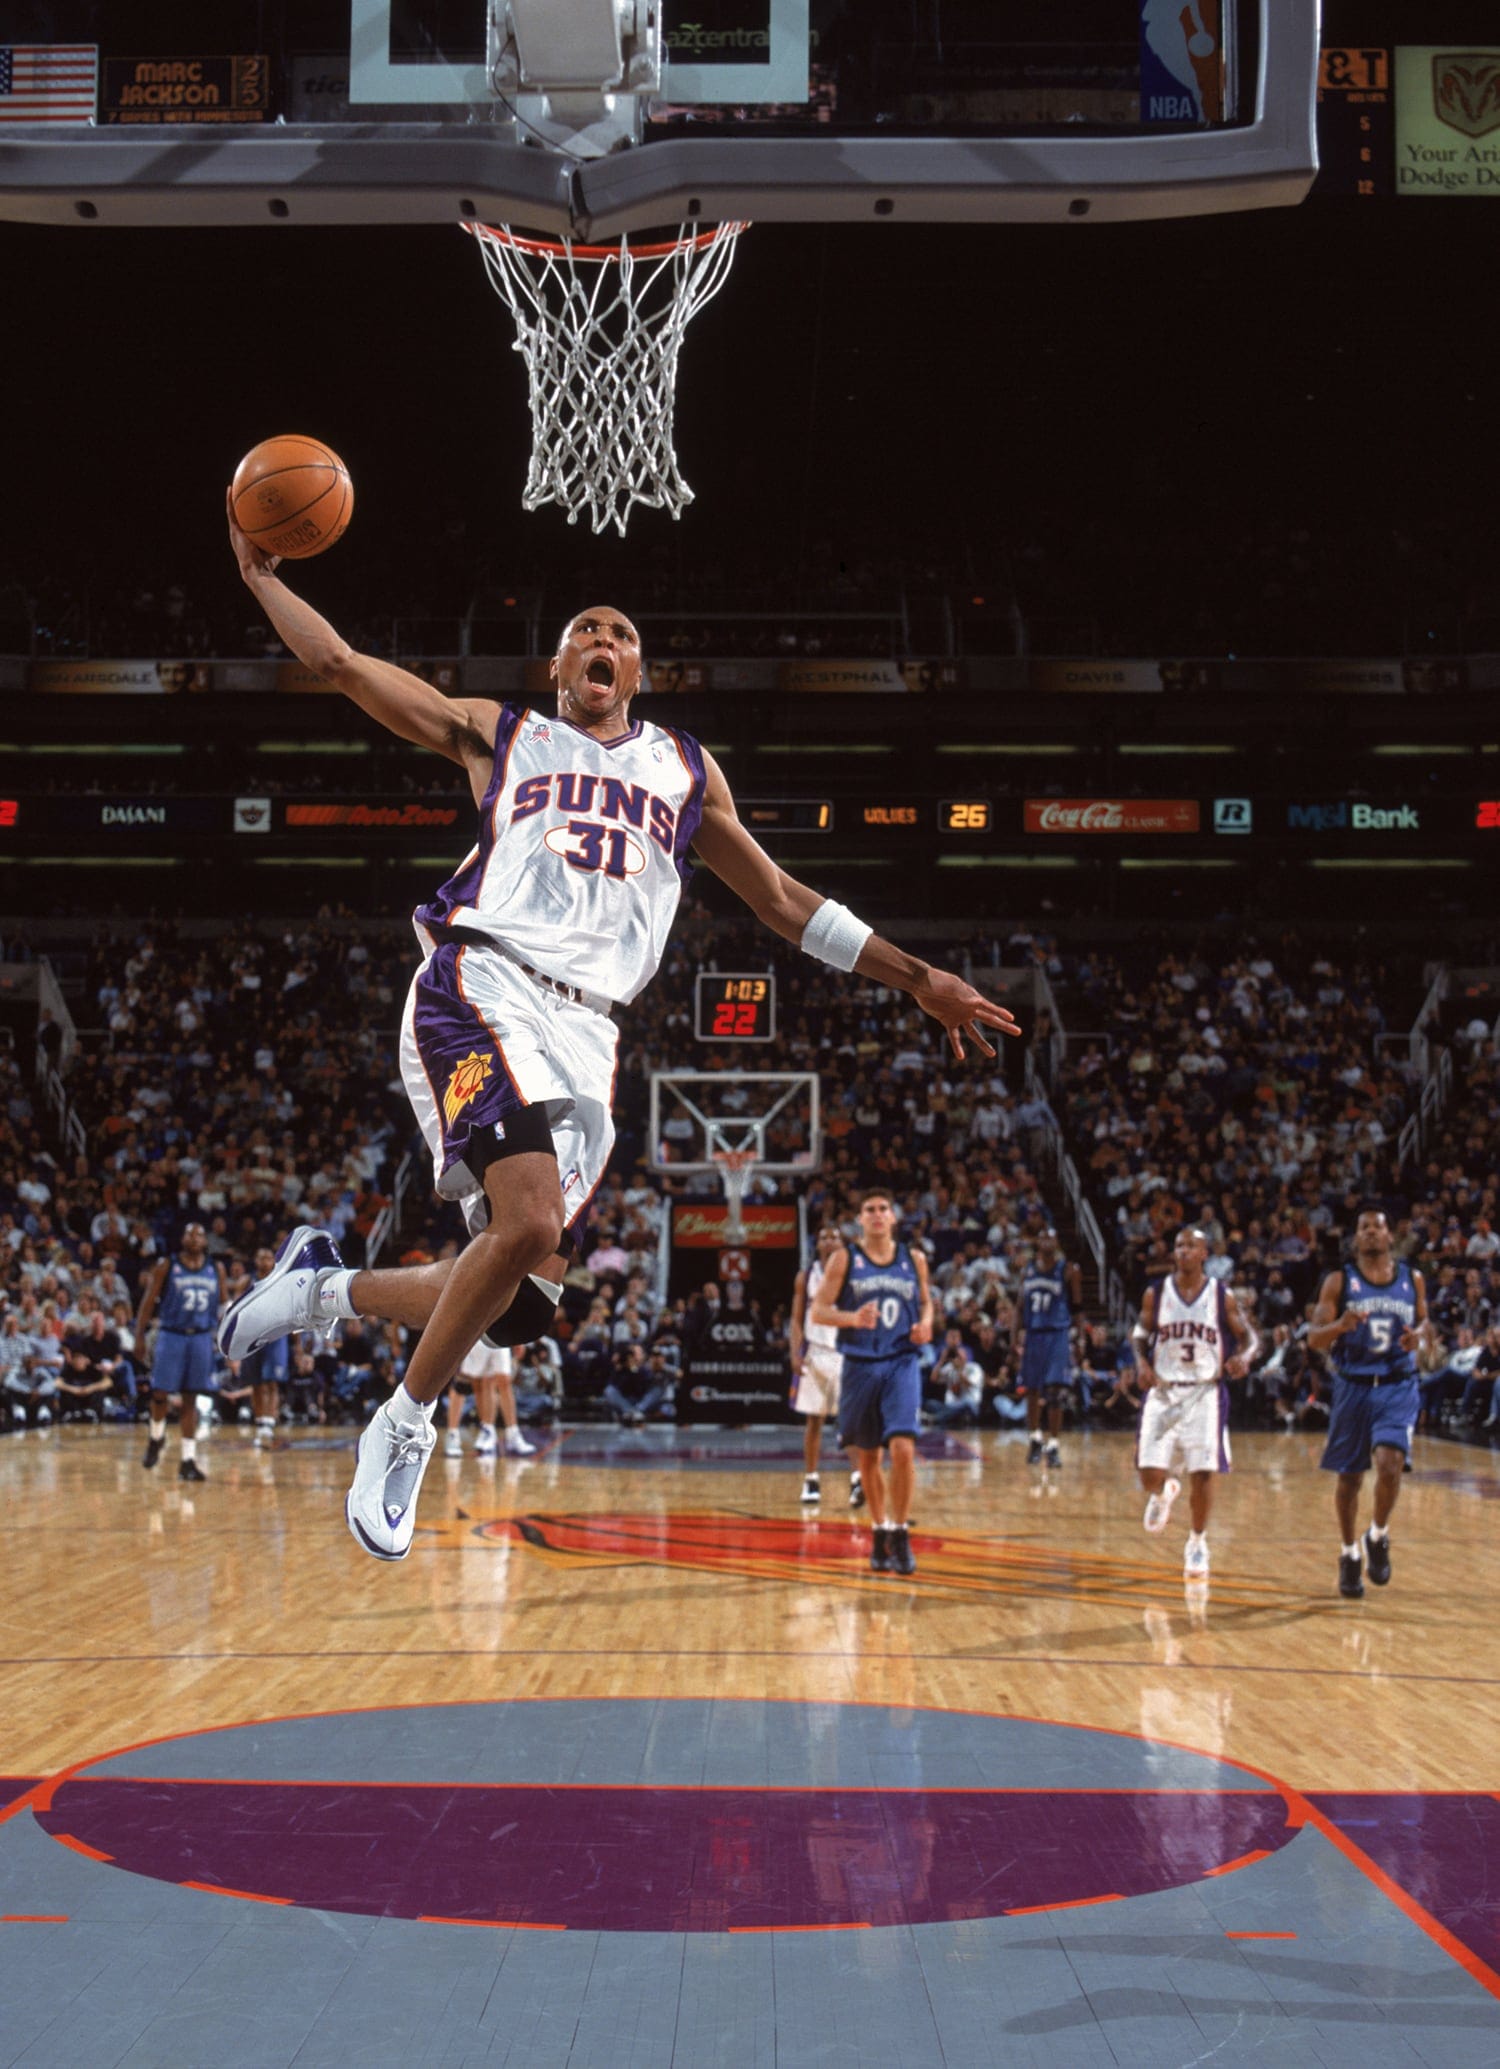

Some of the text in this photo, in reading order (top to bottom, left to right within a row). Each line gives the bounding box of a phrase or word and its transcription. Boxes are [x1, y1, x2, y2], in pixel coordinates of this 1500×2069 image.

[134, 61, 203, 83] MARC
[119, 83, 220, 106] JACKSON
[1149, 95, 1193, 119] NBA
[1407, 144, 1500, 162] Your Ari
[1400, 167, 1469, 189] Dodge
[1065, 670, 1125, 683] DAVIS
[101, 805, 166, 825] DASANI
[347, 804, 458, 825] AutoZone
[510, 773, 675, 854] SUNS
[818, 804, 829, 828] 1
[949, 804, 988, 828] 26
[1352, 803, 1419, 829] Bank
[1476, 801, 1500, 828] 2
[565, 820, 627, 880] 31
[724, 979, 766, 1001] 1:03
[713, 1003, 757, 1034] 22
[674, 1211, 795, 1237] Budeiser
[183, 1288, 209, 1312] 25
[881, 1297, 900, 1329] 0
[711, 1322, 754, 1342] COX
[1159, 1321, 1217, 1345] SUNS
[1369, 1318, 1394, 1352] 5
[1181, 1343, 1195, 1362] 3
